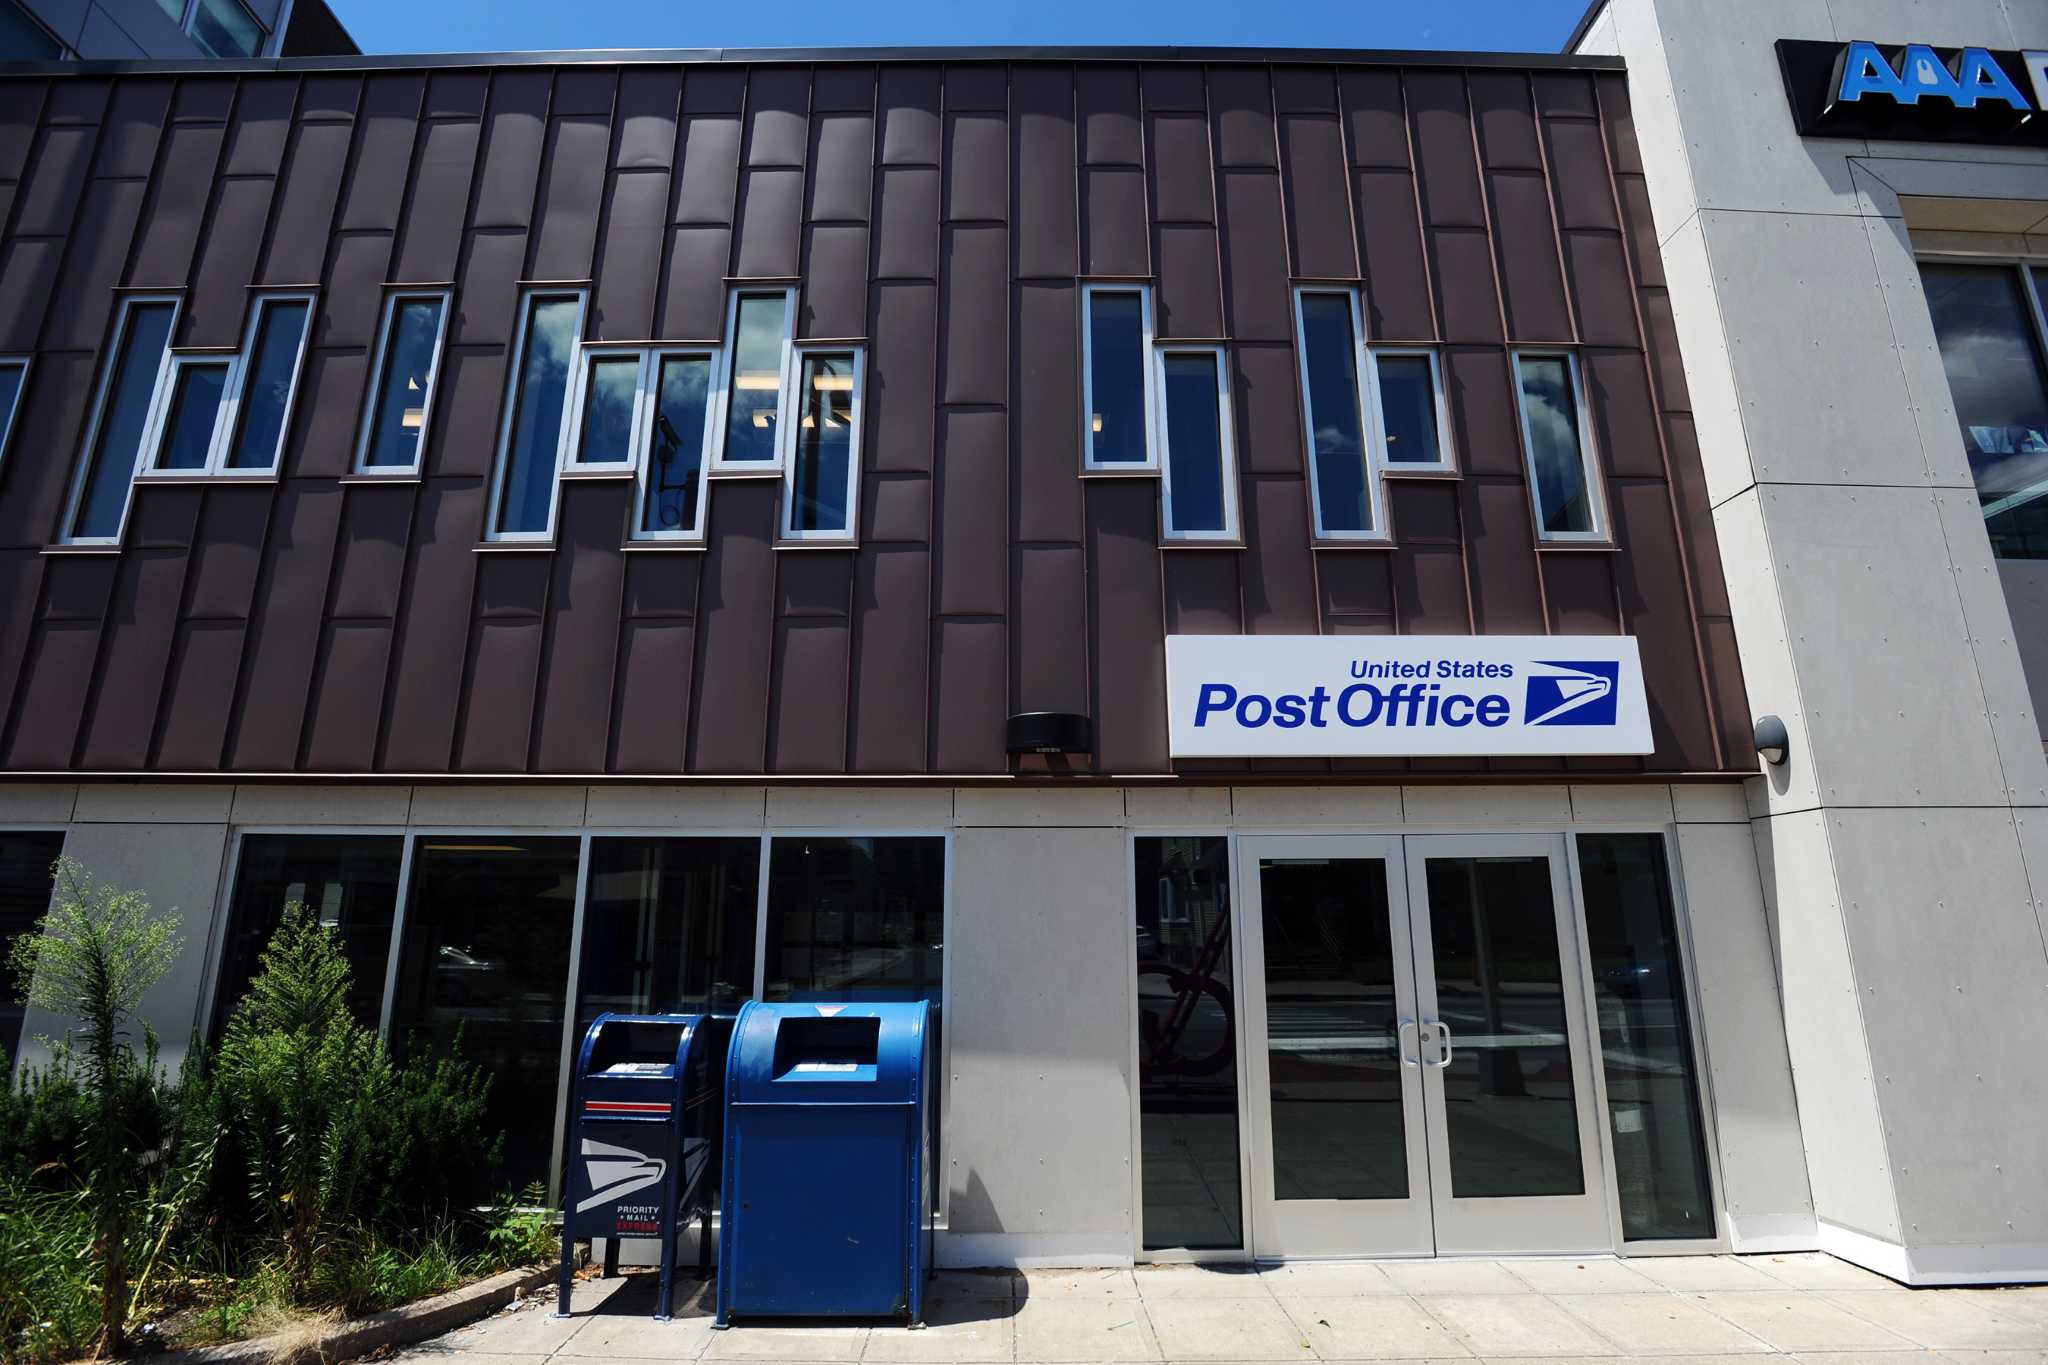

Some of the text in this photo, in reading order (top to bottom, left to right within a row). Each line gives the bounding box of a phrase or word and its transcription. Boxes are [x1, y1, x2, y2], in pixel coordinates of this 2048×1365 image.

[1838, 40, 2033, 110] AAA
[1350, 660, 1513, 679] United States
[1193, 683, 1511, 729] Post Office
[616, 1206, 660, 1214] PRIORITY
[626, 1214, 649, 1222] MAIL
